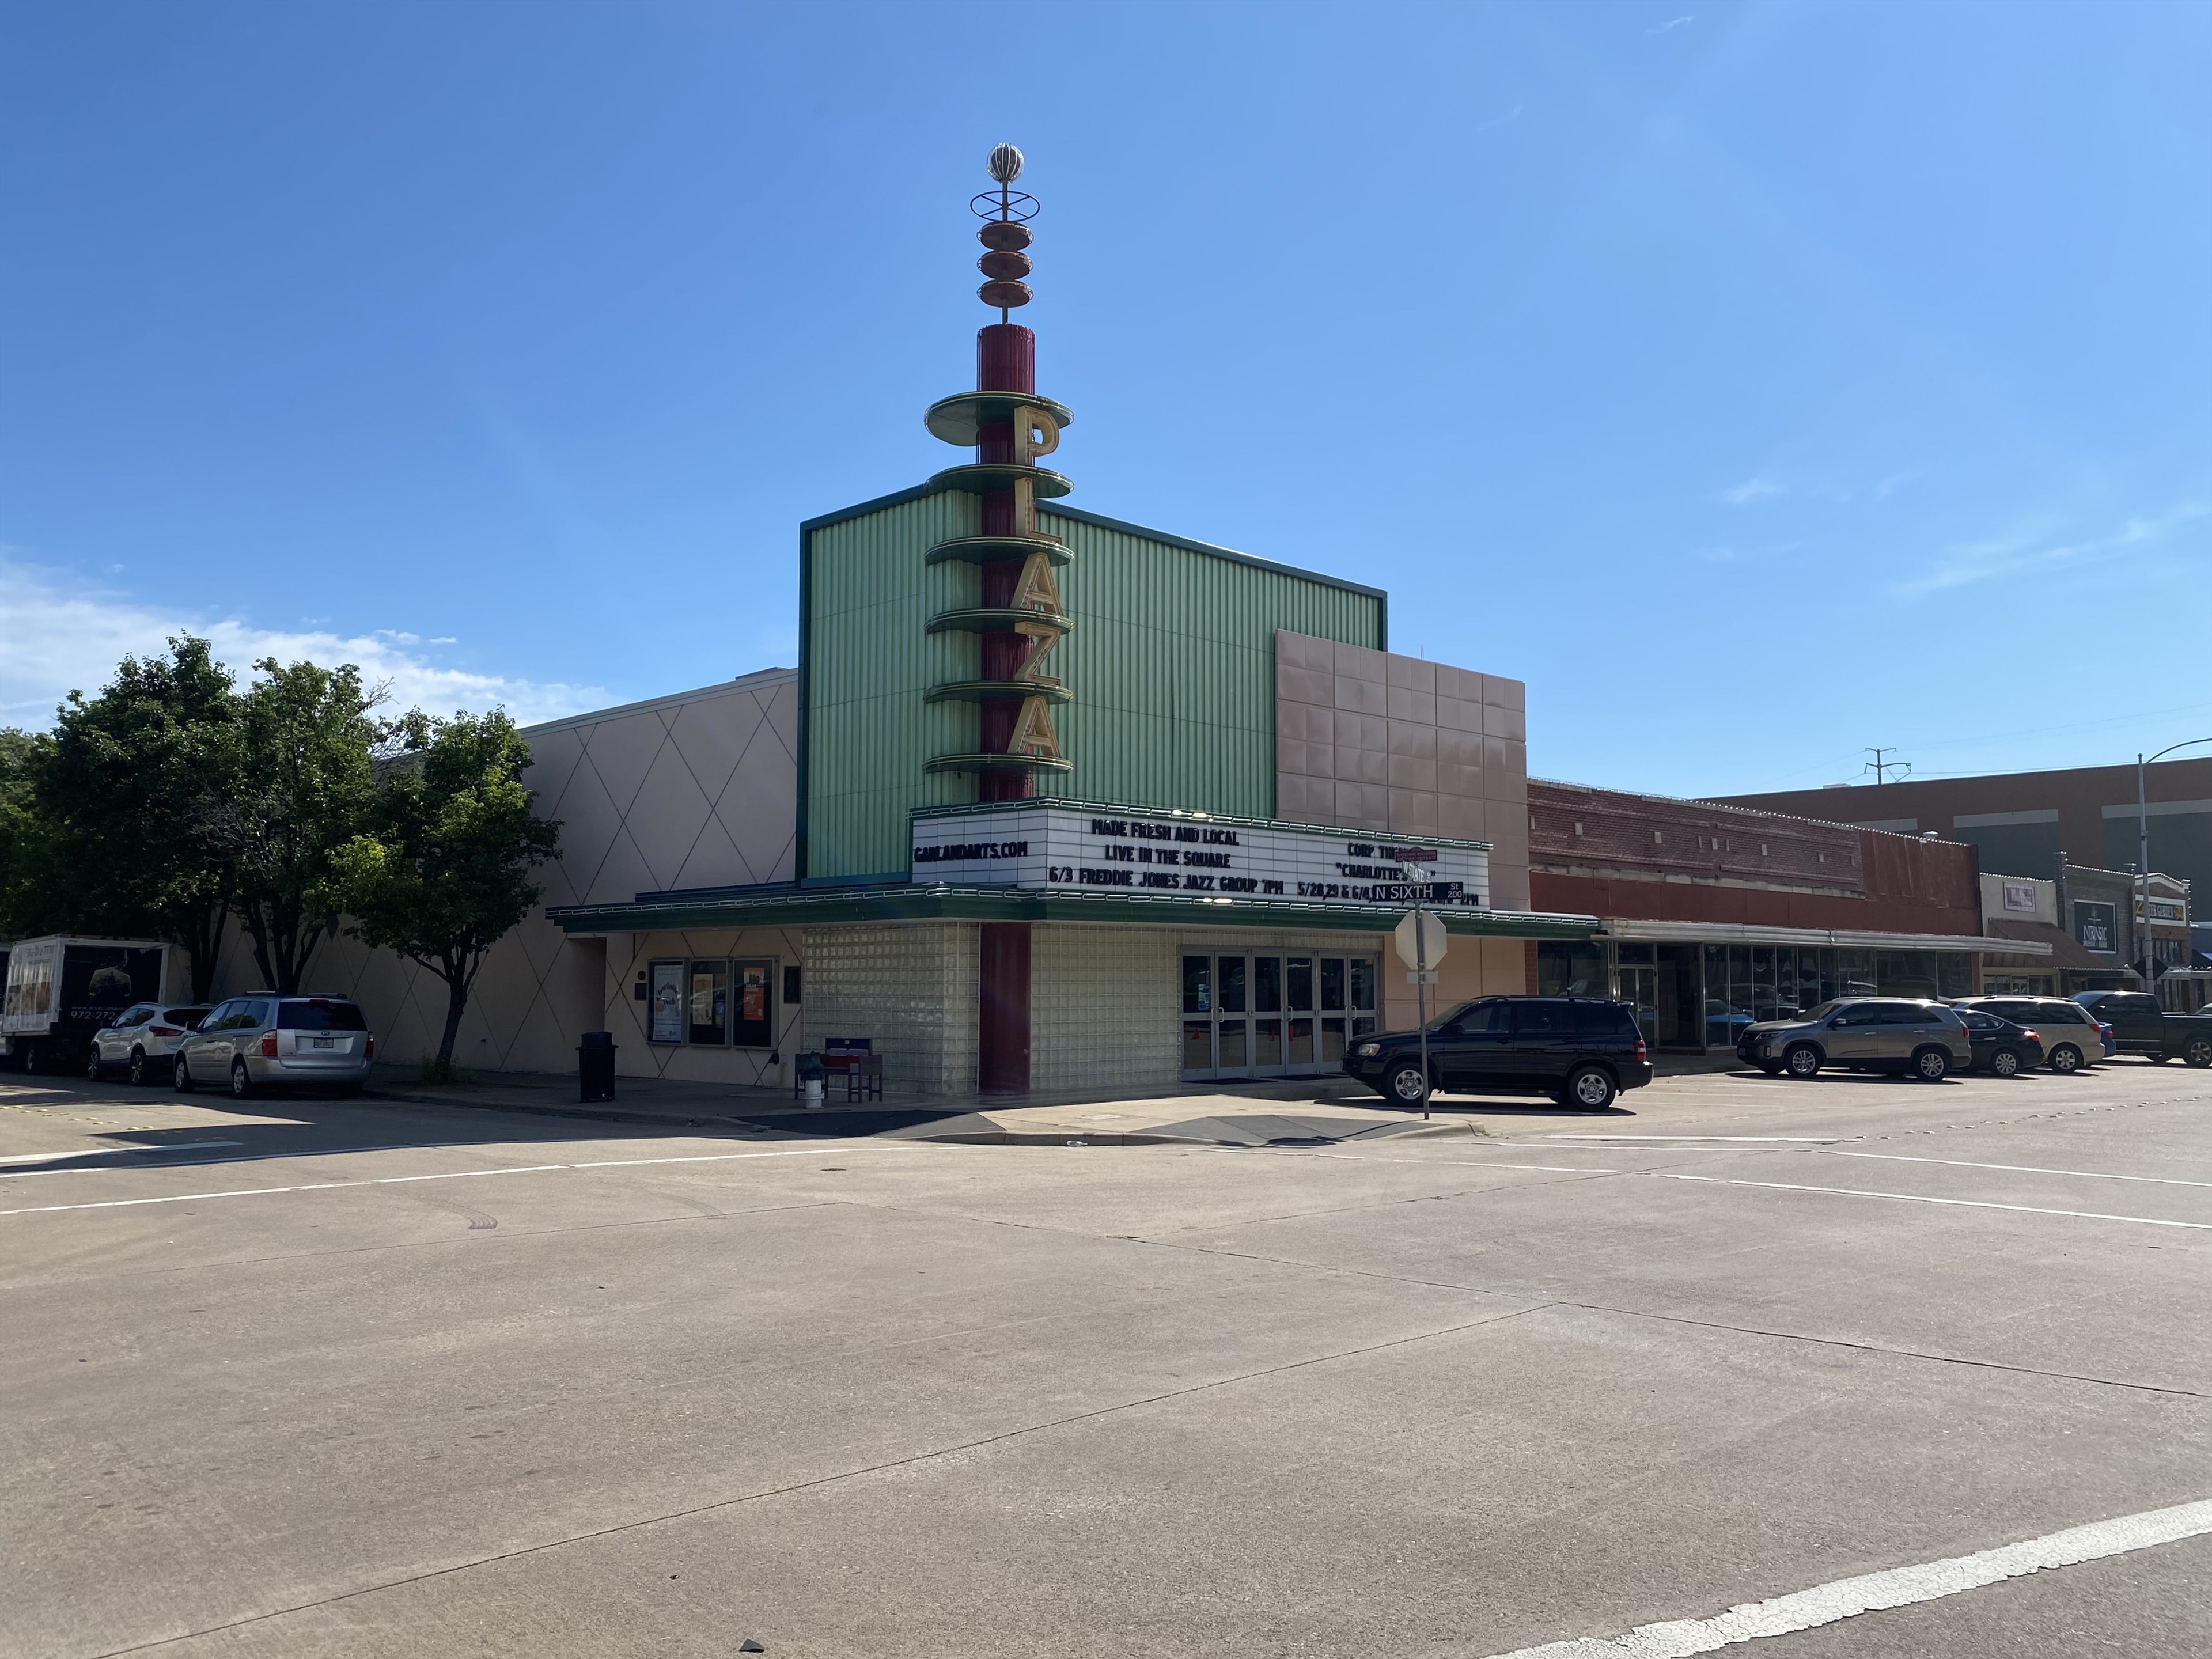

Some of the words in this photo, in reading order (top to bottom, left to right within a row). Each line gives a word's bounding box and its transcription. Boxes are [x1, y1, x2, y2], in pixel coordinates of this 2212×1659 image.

[1007, 405, 1064, 757] PLAZA
[1092, 819, 1128, 836] MADE
[1131, 822, 1171, 840] FRESH
[1175, 826, 1199, 842] AND
[1203, 828, 1240, 846] LOCAL
[914, 841, 1028, 863] GARLANDARTS.COM
[1105, 844, 1134, 862] LIVE
[1139, 846, 1153, 863] IN
[1156, 849, 1179, 865] THE
[1184, 851, 1231, 868] SQUARE
[1347, 843, 1375, 857] CORP
[1049, 866, 1073, 883] 6/3
[1079, 868, 1134, 886] FREDDIE
[1139, 872, 1180, 889] JONES
[1183, 874, 1215, 891] JAZZ
[1219, 876, 1258, 893] GROUP
[1262, 879, 1284, 895] 7PM
[1403, 860, 1408, 874] W
[1408, 863, 1425, 883] STATE
[1376, 886, 1385, 899] N
[1390, 885, 1433, 899] SIXTH
[2083, 925, 2107, 941] INTRINSIC
[70, 1010, 121, 1020] 972-272-
